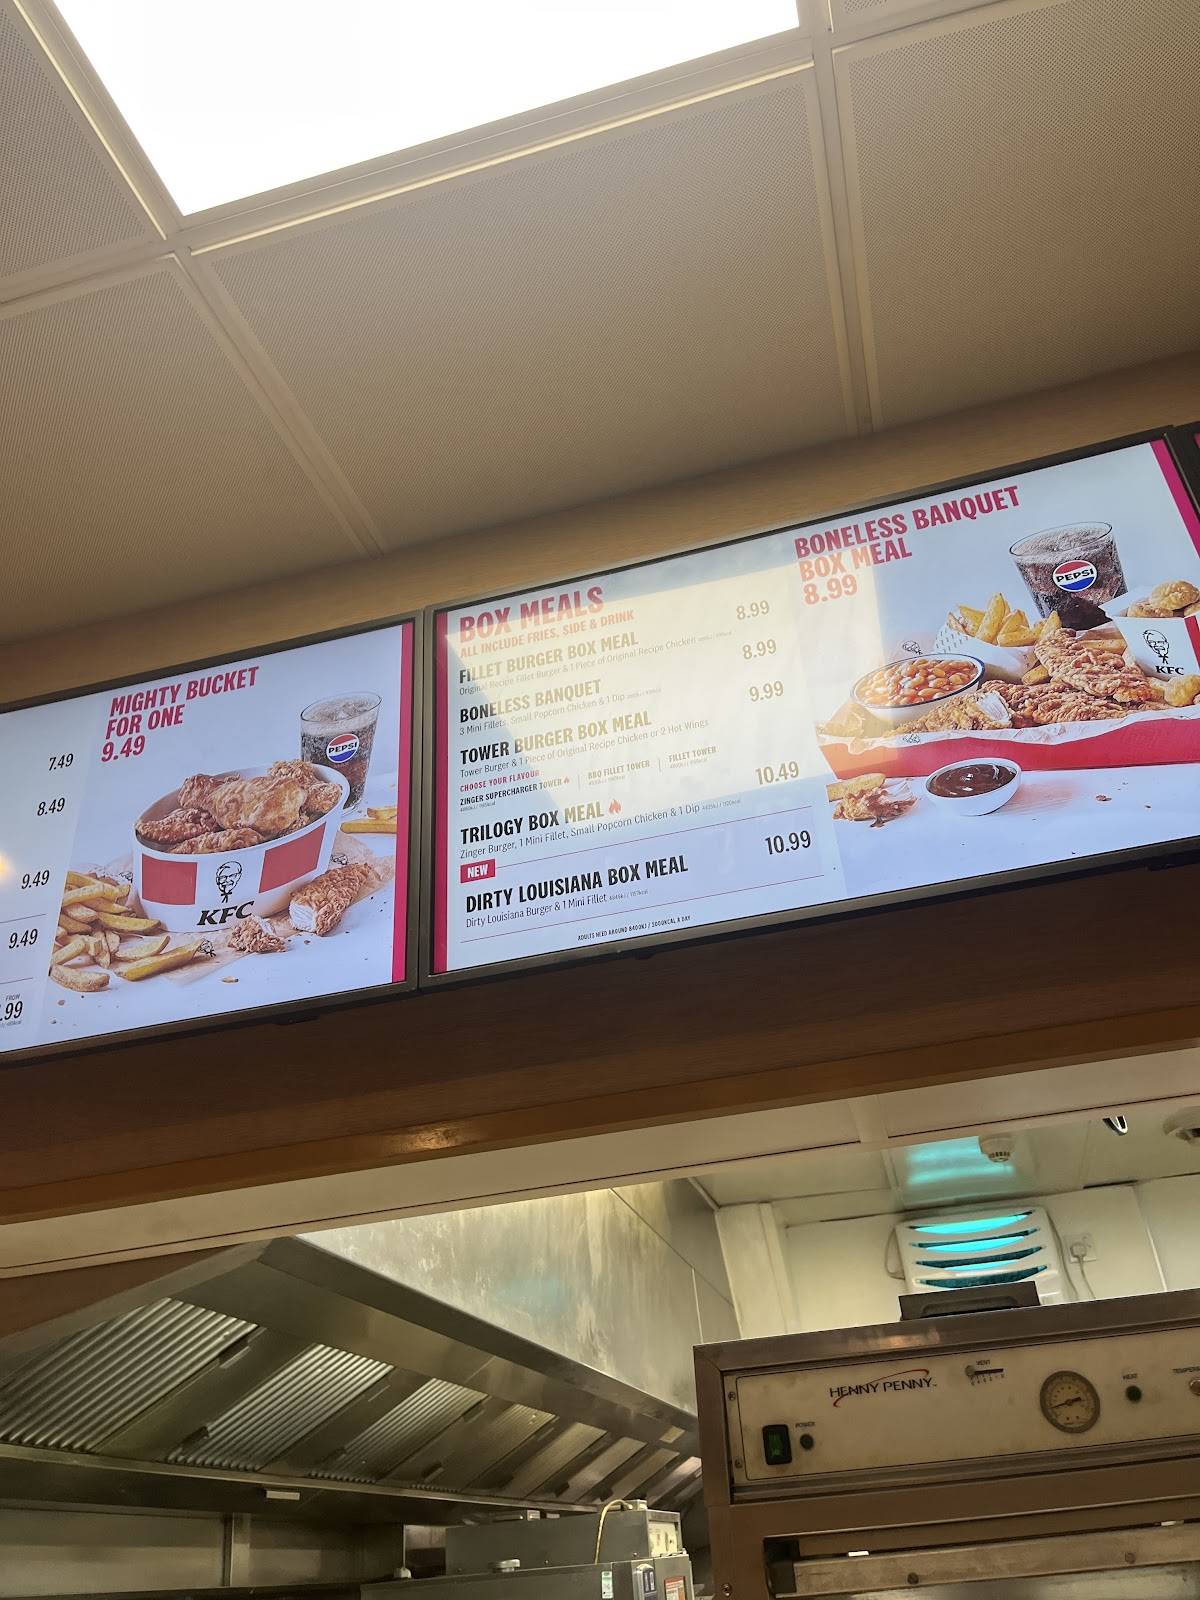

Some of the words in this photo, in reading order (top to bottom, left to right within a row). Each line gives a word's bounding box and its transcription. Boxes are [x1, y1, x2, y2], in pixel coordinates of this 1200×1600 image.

[794, 513, 908, 559] BONELESS
[912, 486, 1021, 530] BANQUET
[799, 552, 847, 582] BOX
[852, 538, 913, 570] MEAL
[1056, 568, 1094, 584] PEPSI
[803, 574, 858, 605] 8.99
[460, 607, 511, 643] BOX
[520, 586, 604, 630] MEALS
[736, 600, 770, 620] 8.99
[460, 647, 478, 658] ALL
[481, 636, 525, 653] INCLUDE
[562, 622, 585, 635] SIDE
[590, 619, 597, 630] &
[600, 609, 635, 627] DRINK
[460, 661, 502, 684] FILLET
[506, 648, 563, 673] BURGER
[568, 640, 597, 659] BOX
[600, 631, 639, 652] MEAL
[742, 639, 777, 660] 8.99
[1155, 665, 1185, 675] KFC
[110, 684, 181, 717] MIGHTY
[186, 666, 259, 700] BUCKET
[460, 695, 530, 723] BONELESS
[535, 679, 601, 706] BANQUET
[749, 681, 784, 702] 9.99
[105, 715, 142, 739] FOR
[148, 704, 185, 730] ONE
[460, 728, 464, 736] 3
[467, 724, 482, 734] Mini
[101, 735, 145, 762] 9.49
[329, 741, 357, 754] PEPSI
[460, 741, 510, 765] TOWER
[515, 728, 573, 753] BURGER
[578, 720, 608, 740] BOX
[612, 711, 652, 732] MEAL
[49, 753, 73, 771] 7.49
[460, 766, 482, 778] Tower
[485, 762, 509, 774] Burger
[512, 759, 517, 767] &
[617, 731, 648, 745] Chicken
[460, 781, 486, 793] CHOOSE
[489, 776, 507, 788] YOUR
[755, 761, 800, 785] 10.49
[460, 794, 484, 806] ZINGER
[485, 784, 538, 801] SUPERCHARGER
[539, 778, 562, 790] TOWER
[37, 798, 65, 816] 8.49
[460, 817, 524, 844] TRILOGY
[528, 810, 560, 831] BOX
[564, 801, 605, 824] MEAL
[460, 846, 486, 860] Zinger
[525, 835, 543, 847] Mini
[571, 823, 594, 837] Small
[597, 819, 632, 833] Popcorn
[634, 810, 668, 825] Chicken
[670, 807, 677, 817] &
[685, 804, 700, 817] Dip
[765, 830, 811, 855] 10.99
[21, 870, 50, 889] 9.49
[467, 864, 489, 878] NEW
[466, 888, 513, 913] DIRTY
[518, 871, 603, 903] LOUISIANA
[608, 863, 641, 886] BOX
[645, 855, 689, 879] MEAL
[197, 901, 254, 926] KFC
[466, 917, 486, 928] Dirty
[487, 909, 524, 924] Louisiana
[526, 904, 553, 917] Burger
[554, 901, 561, 911] &
[568, 896, 585, 908] Mini
[587, 893, 607, 905] Fillet
[9, 928, 38, 949] 9.49
[0, 1000, 23, 1021] .99
[829, 1383, 879, 1398] HENNY
[883, 1377, 933, 1392] PENNY
